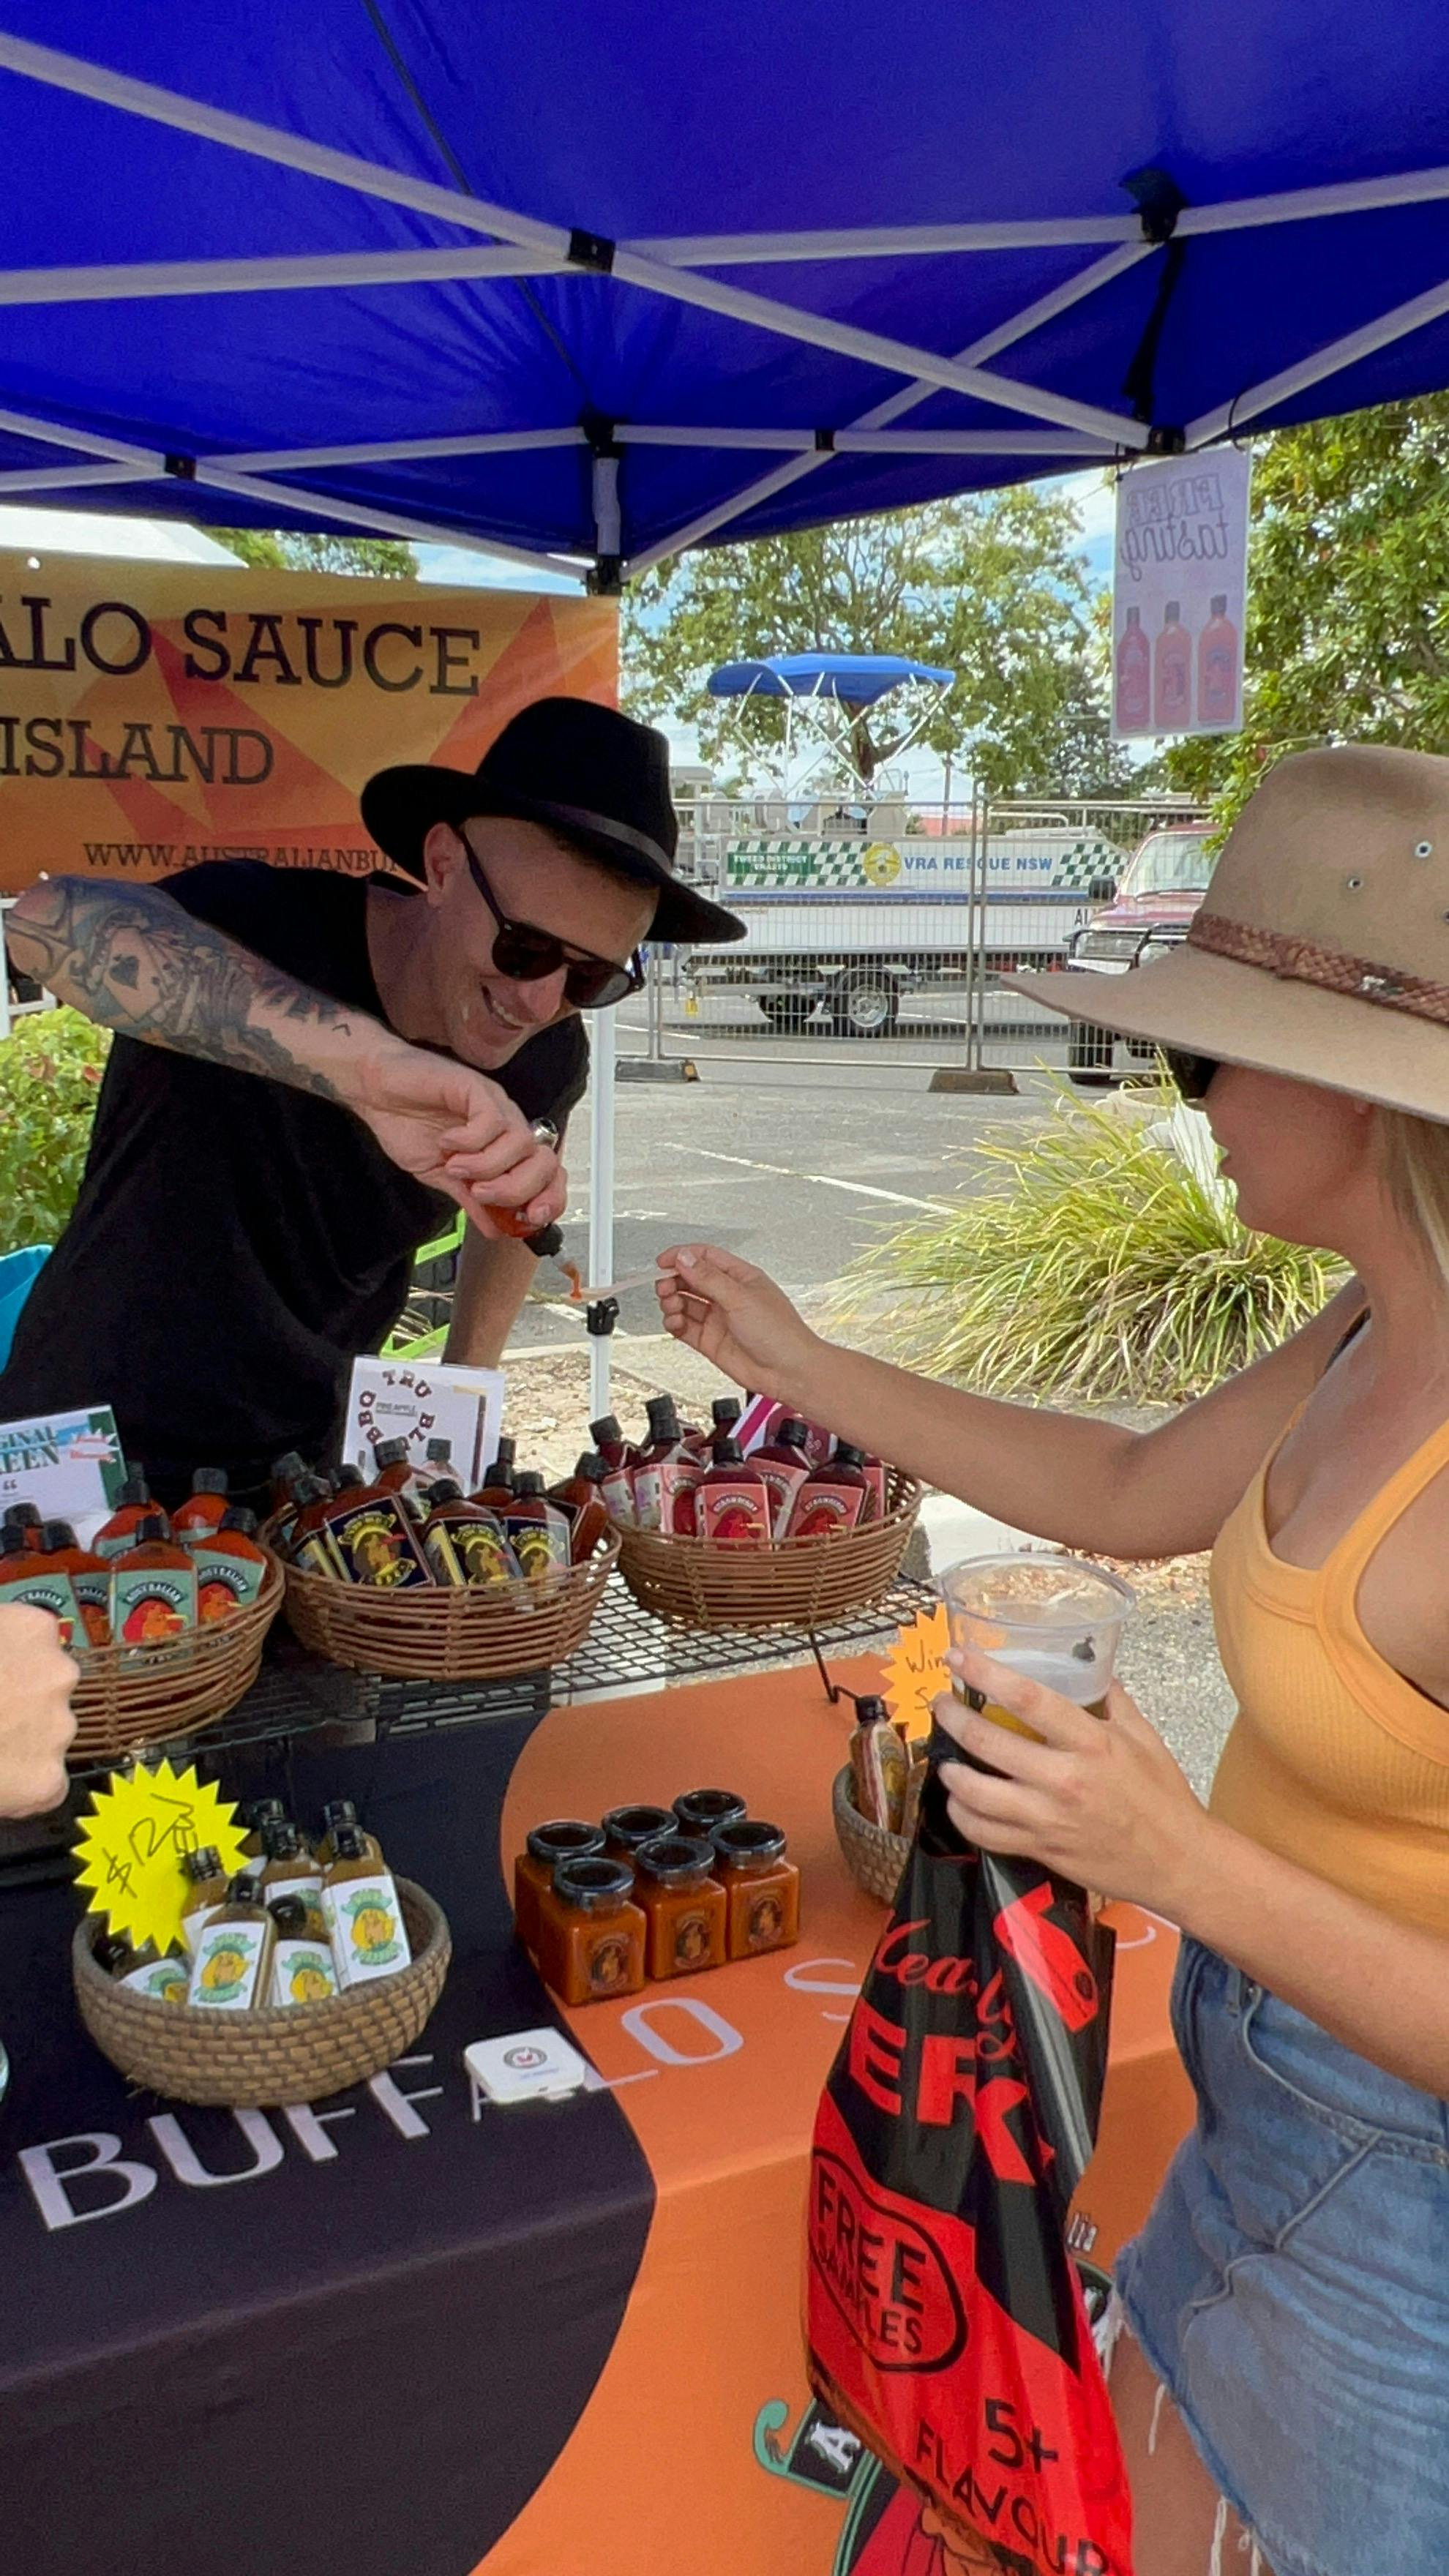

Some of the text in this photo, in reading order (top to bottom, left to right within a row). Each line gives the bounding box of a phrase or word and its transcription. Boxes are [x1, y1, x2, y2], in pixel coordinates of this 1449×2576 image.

[184, 610, 480, 696] SAUCE
[0, 716, 274, 785] ISLAND
[904, 857, 1053, 871] VRA RESCUE NSW
[382, 1369, 433, 1398] TRU
[17, 1997, 745, 2232] BUFFLO
[818, 2163, 926, 2315] FREE
[984, 2397, 1059, 2474] 5+
